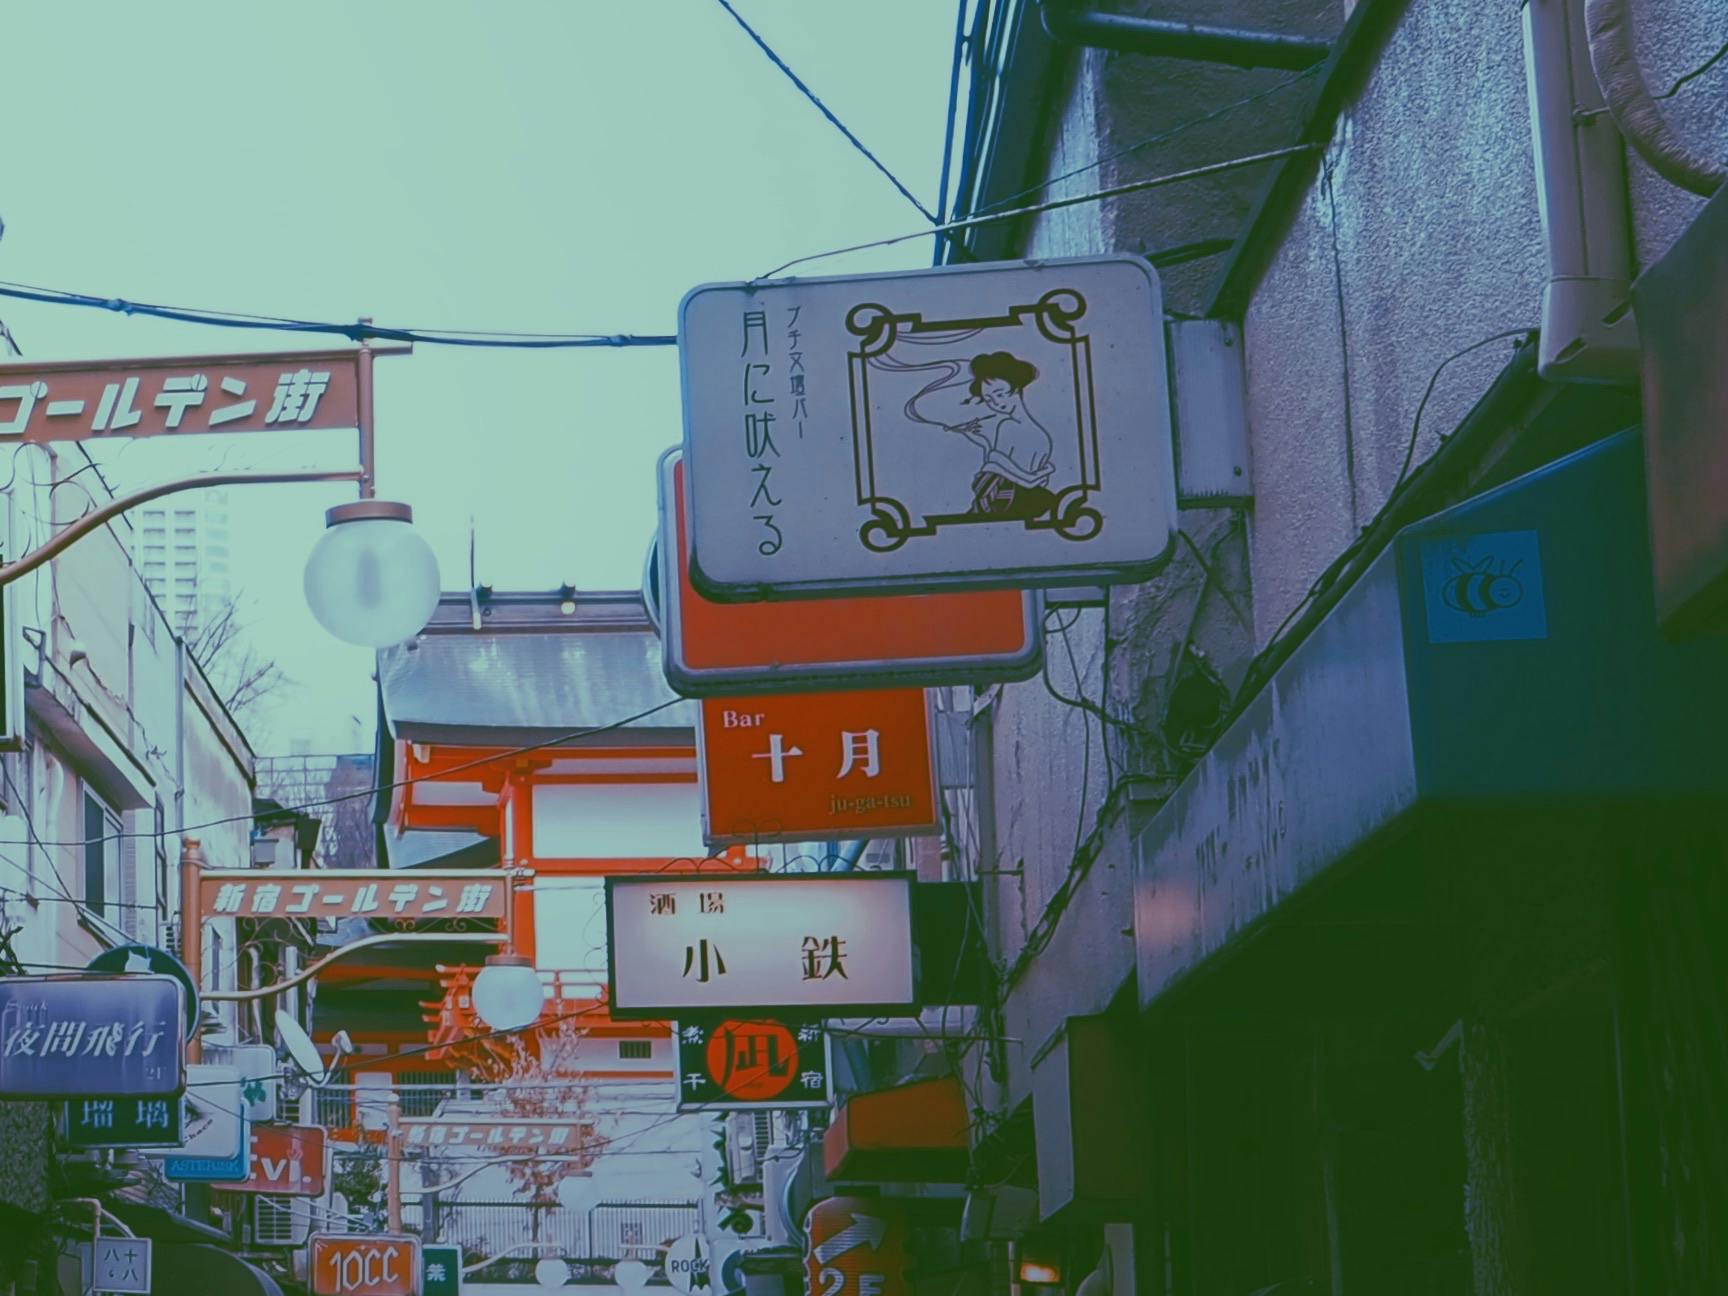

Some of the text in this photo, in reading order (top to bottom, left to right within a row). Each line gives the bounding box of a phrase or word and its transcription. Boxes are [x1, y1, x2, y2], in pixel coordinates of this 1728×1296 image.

[741, 309, 783, 557] 月に吠える
[722, 709, 766, 730] Bar
[751, 728, 881, 784] 十月
[212, 882, 493, 914] 新宿ゴールデン街
[649, 892, 725, 916] 酒場
[682, 935, 849, 983] 小鉄
[3, 1020, 168, 1057] 夜間飛行
[721, 1024, 790, 1090] 凪
[329, 1245, 401, 1294] 10CC
